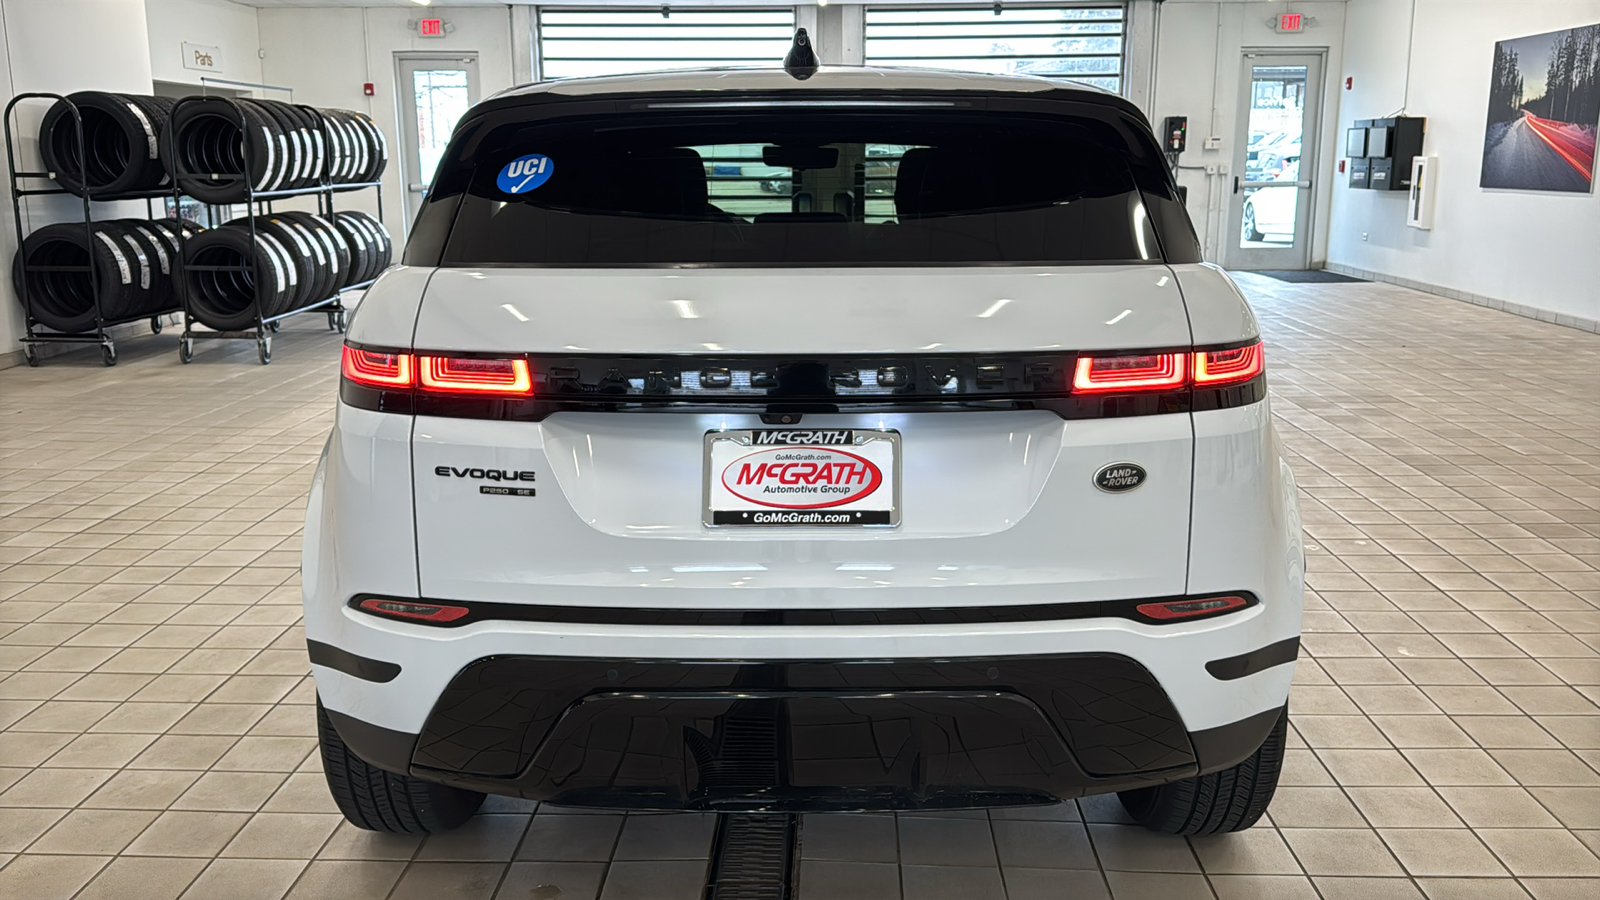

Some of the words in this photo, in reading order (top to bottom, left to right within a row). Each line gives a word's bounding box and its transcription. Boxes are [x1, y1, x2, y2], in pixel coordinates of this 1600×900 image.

[421, 19, 440, 35] EXIT
[1281, 14, 1301, 30] EXIT
[194, 50, 213, 67] Parts
[508, 157, 547, 178] UCI
[550, 366, 778, 389] RANGE
[435, 466, 536, 482] EVOQUE
[1106, 468, 1132, 479] LAND
[1107, 476, 1139, 487] ROVER
[482, 487, 509, 495] P250
[763, 485, 818, 493] Automotive
[820, 485, 851, 495] Group
[753, 512, 850, 523] GoMcGrath.com
